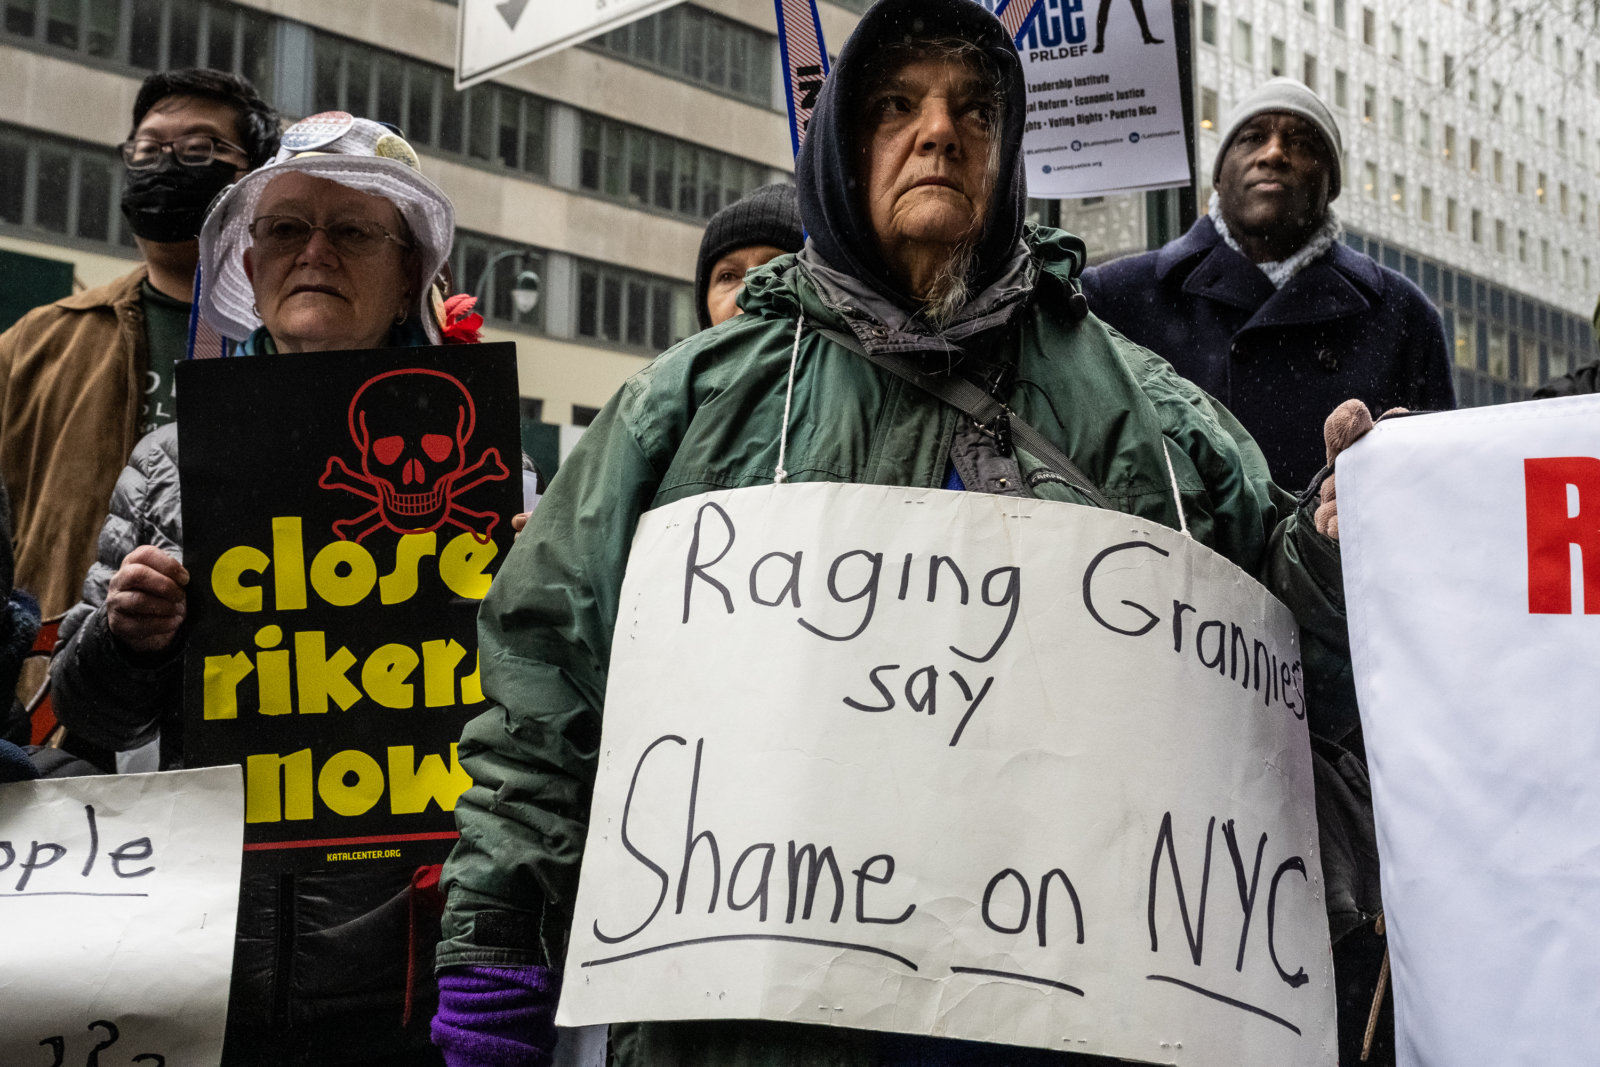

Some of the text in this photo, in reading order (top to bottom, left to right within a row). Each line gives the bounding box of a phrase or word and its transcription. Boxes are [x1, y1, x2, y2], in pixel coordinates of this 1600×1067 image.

[1029, 45, 1089, 63] PRLDEF
[1027, 74, 1110, 93] Leadership Institute
[1038, 98, 1068, 111] Reform
[1075, 91, 1114, 106] Economic
[1116, 87, 1146, 101] Justice
[1048, 115, 1075, 128] Voting
[1077, 112, 1103, 125] Rights
[1109, 107, 1137, 120] Puerto
[1138, 105, 1157, 116] Rico
[211, 515, 499, 613] close
[682, 501, 1306, 721] Raging Grannies
[843, 664, 995, 747] say
[246, 742, 473, 824] now
[326, 848, 401, 862] KATALCENTER.ORG
[593, 735, 1309, 988] Shame on NYC
